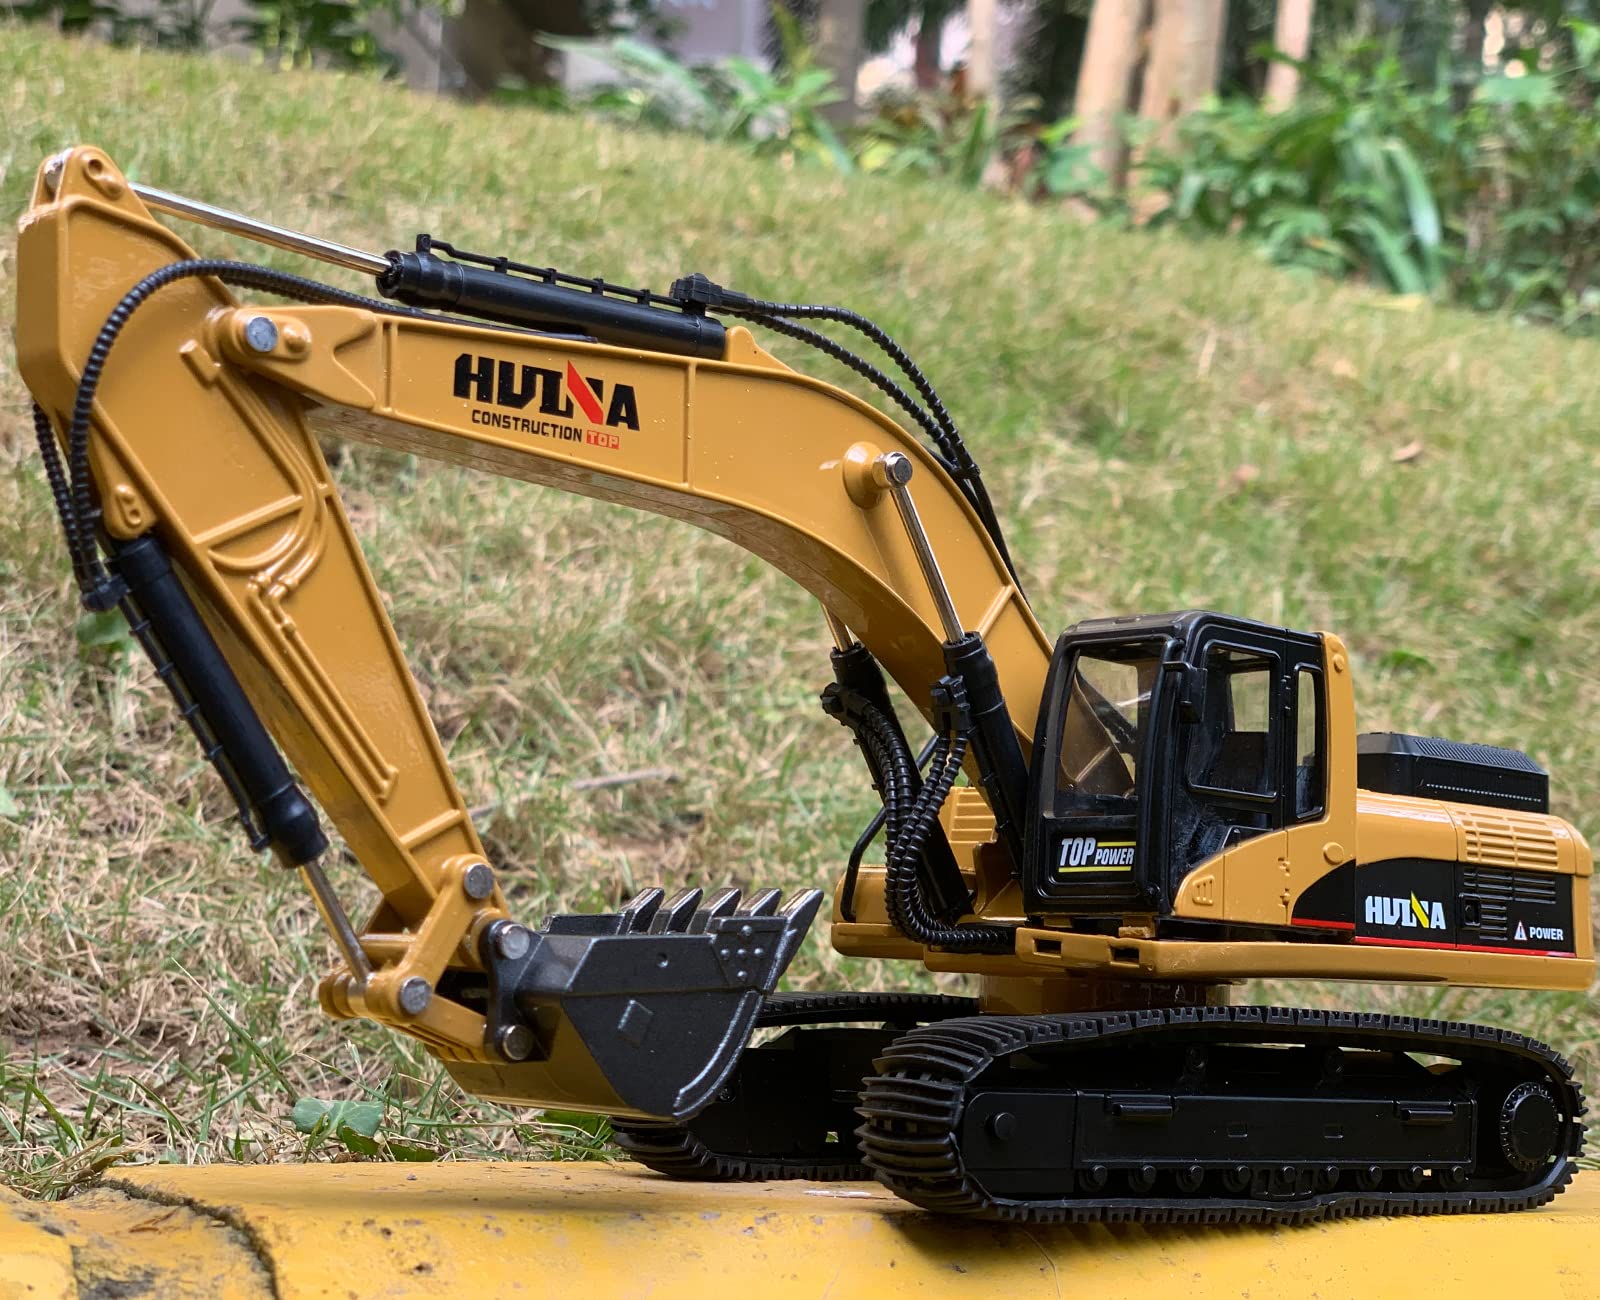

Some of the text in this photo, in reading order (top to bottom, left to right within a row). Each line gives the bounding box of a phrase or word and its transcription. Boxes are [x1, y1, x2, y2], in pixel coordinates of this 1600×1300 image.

[471, 409, 620, 450] CONSTRUCTION TOP
[1060, 837, 1135, 866] TOP POWER
[1529, 926, 1564, 941] POWER
